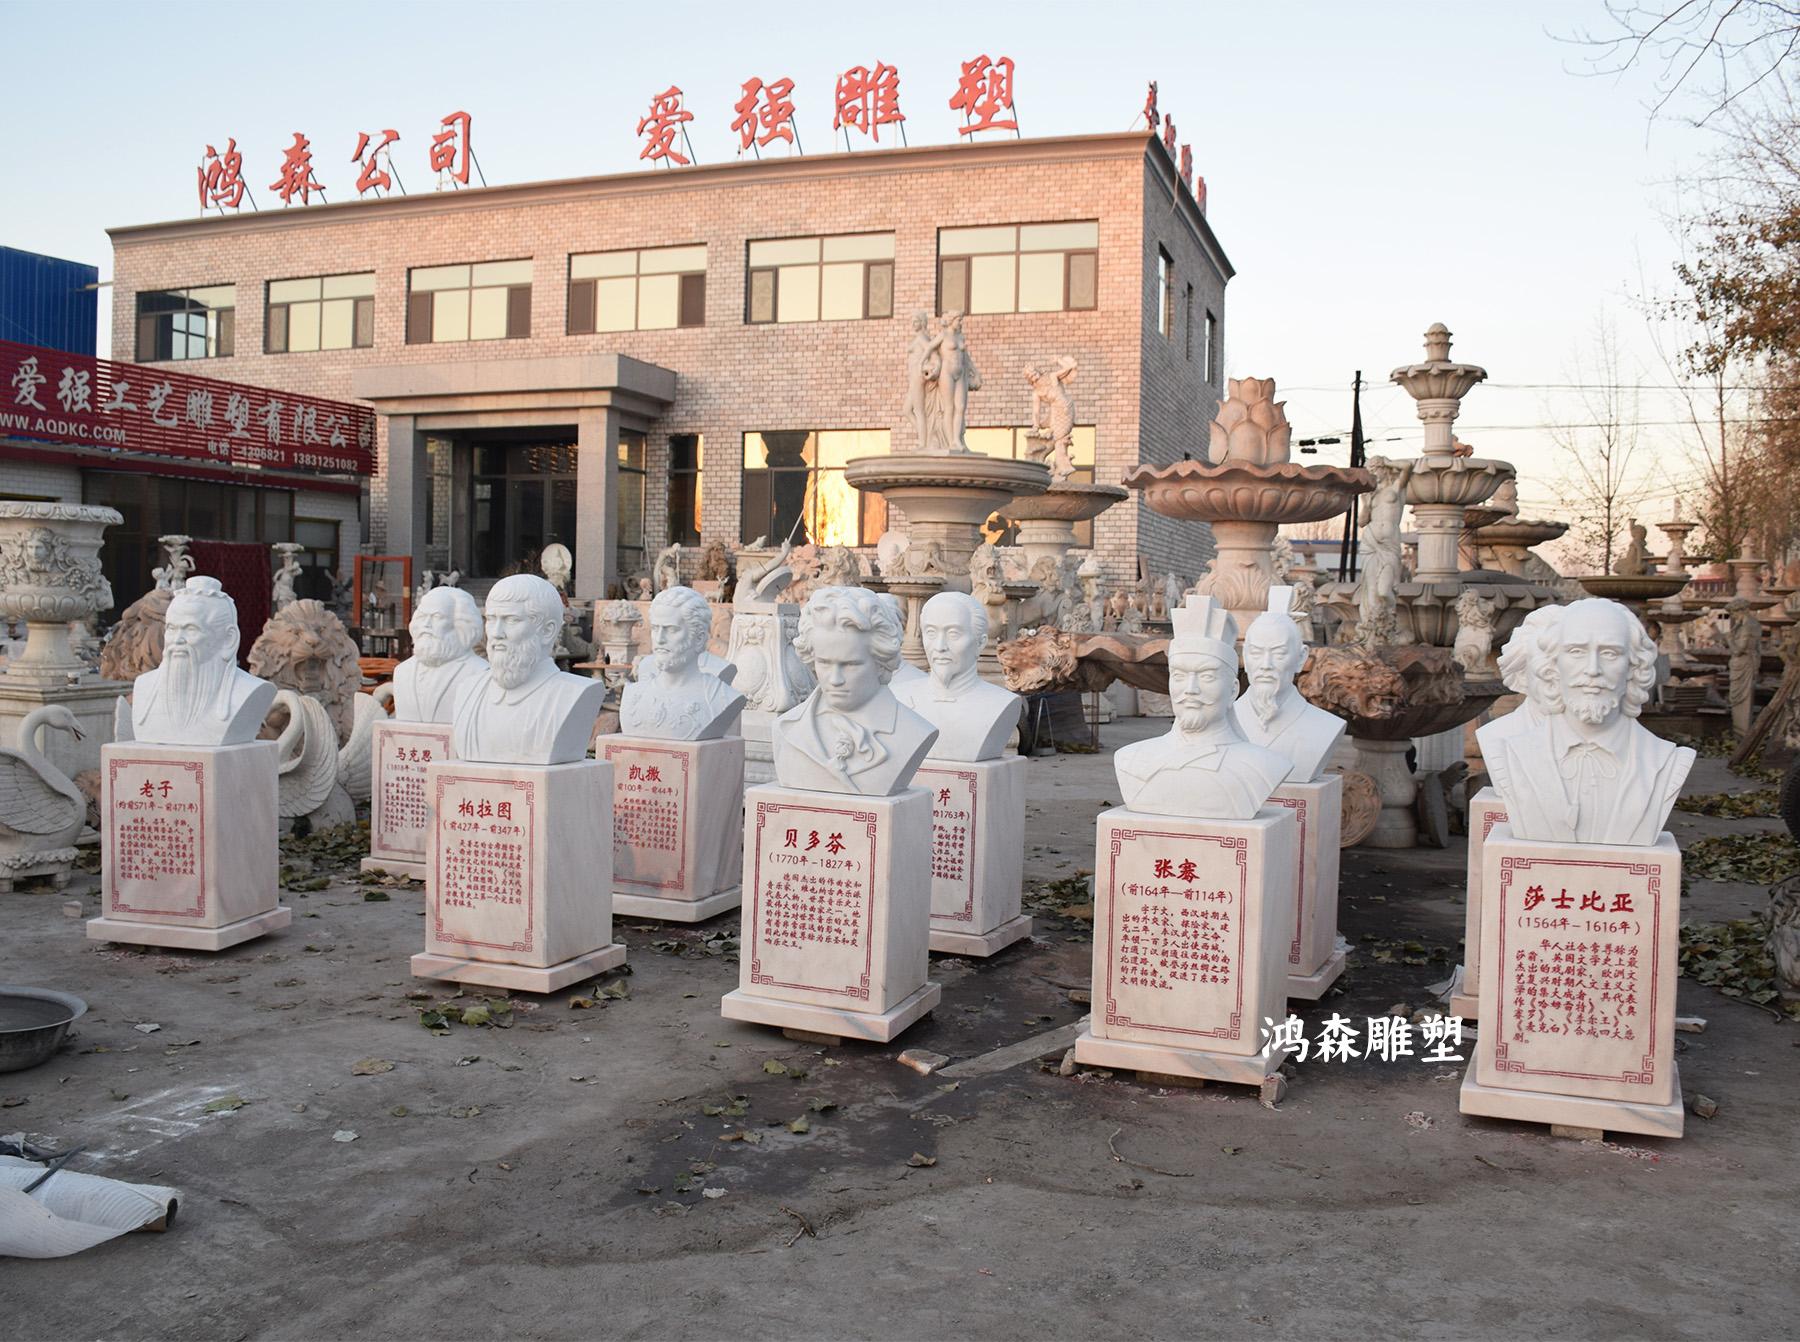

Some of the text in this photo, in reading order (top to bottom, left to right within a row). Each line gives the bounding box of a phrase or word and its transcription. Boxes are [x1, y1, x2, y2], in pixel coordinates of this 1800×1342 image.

[198, 54, 1018, 208] 鸿森公司 爱强雕塑
[11, 356, 376, 453] 爱强工艺雕塑有限公司
[293, 452, 358, 471] 13831251082
[396, 747, 432, 763] 马克思
[629, 764, 662, 782] 凯撒
[139, 780, 173, 798] 老子
[932, 788, 951, 806] 芹
[459, 798, 512, 820] 柏拉图
[784, 829, 846, 855] 贝多芬
[1153, 858, 1200, 883] 张骞
[1523, 885, 1634, 913] 莎士比亚
[1540, 939, 1638, 956] 华人社会常尊称为
[1516, 973, 1636, 992] 艺复兴时期人文主义文
